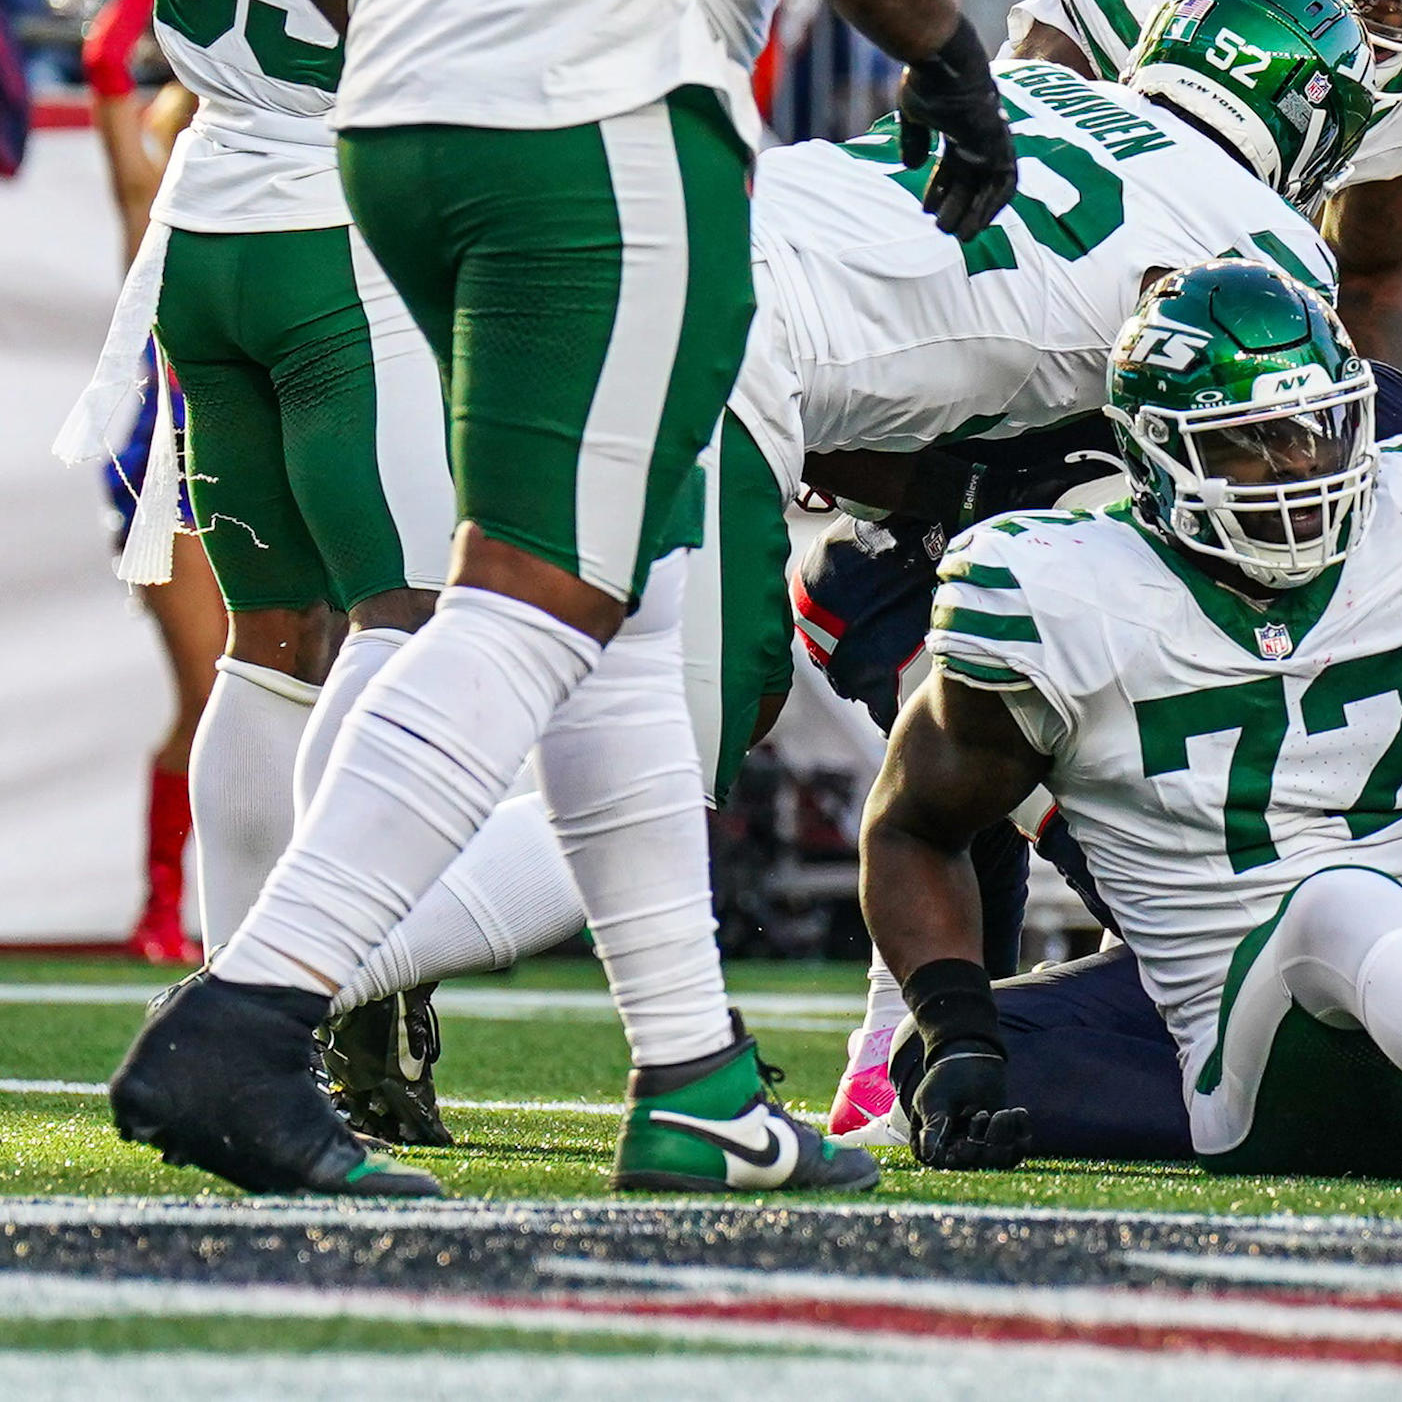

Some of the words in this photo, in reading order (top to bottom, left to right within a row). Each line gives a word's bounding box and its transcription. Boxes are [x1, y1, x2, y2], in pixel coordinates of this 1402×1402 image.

[1205, 26, 1273, 90] 52
[999, 64, 1178, 162] EGUAVOEN
[1176, 78, 1210, 96] NEW
[1210, 93, 1247, 124] YORK
[1274, 372, 1312, 394] NY
[962, 473, 981, 511] Believe
